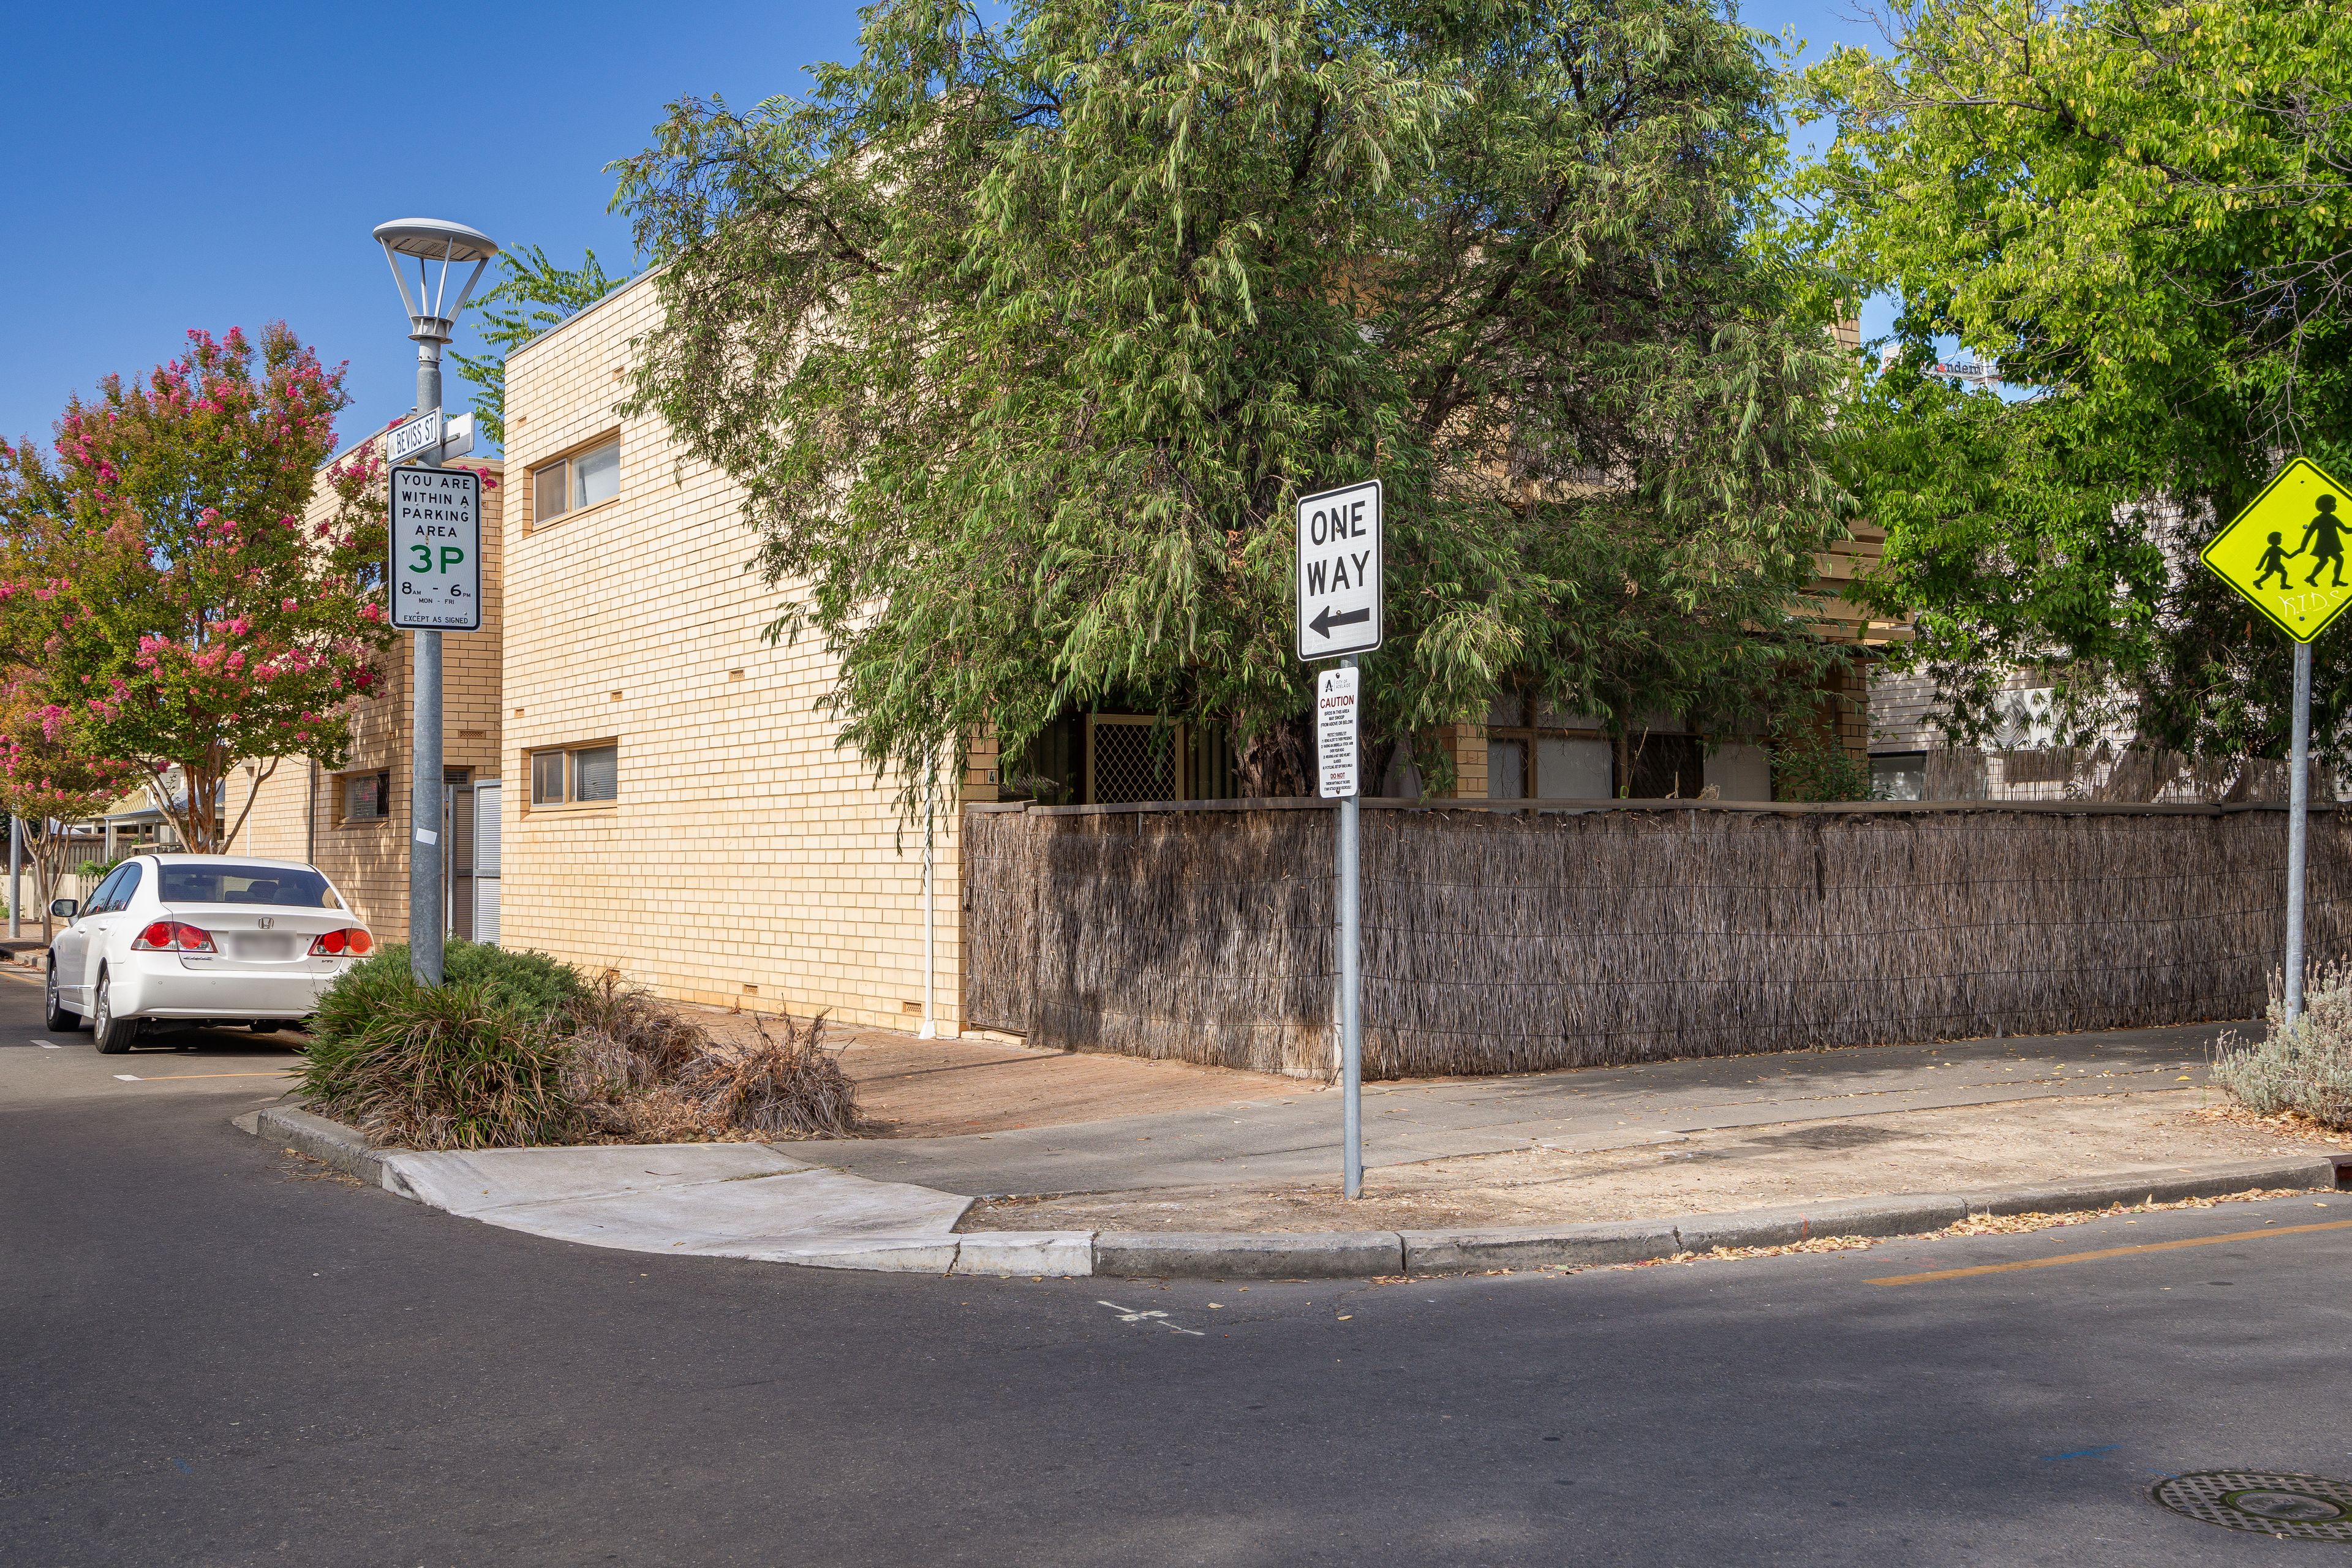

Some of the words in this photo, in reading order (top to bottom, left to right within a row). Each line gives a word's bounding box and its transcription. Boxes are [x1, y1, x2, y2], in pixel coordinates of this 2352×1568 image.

[397, 423, 421, 454] BEVISS
[425, 417, 434, 441] ST
[402, 474, 431, 486] YOU
[441, 478, 470, 489] ARE
[402, 491, 452, 505] WITHIN
[461, 496, 469, 506] A
[403, 508, 469, 522] PARKING
[1311, 500, 1366, 545] ONE
[415, 526, 457, 537] AREA
[409, 545, 464, 574] 3P
[1307, 550, 1370, 597] WAY
[1321, 695, 1354, 709] CAUTION
[989, 771, 994, 783] 4
